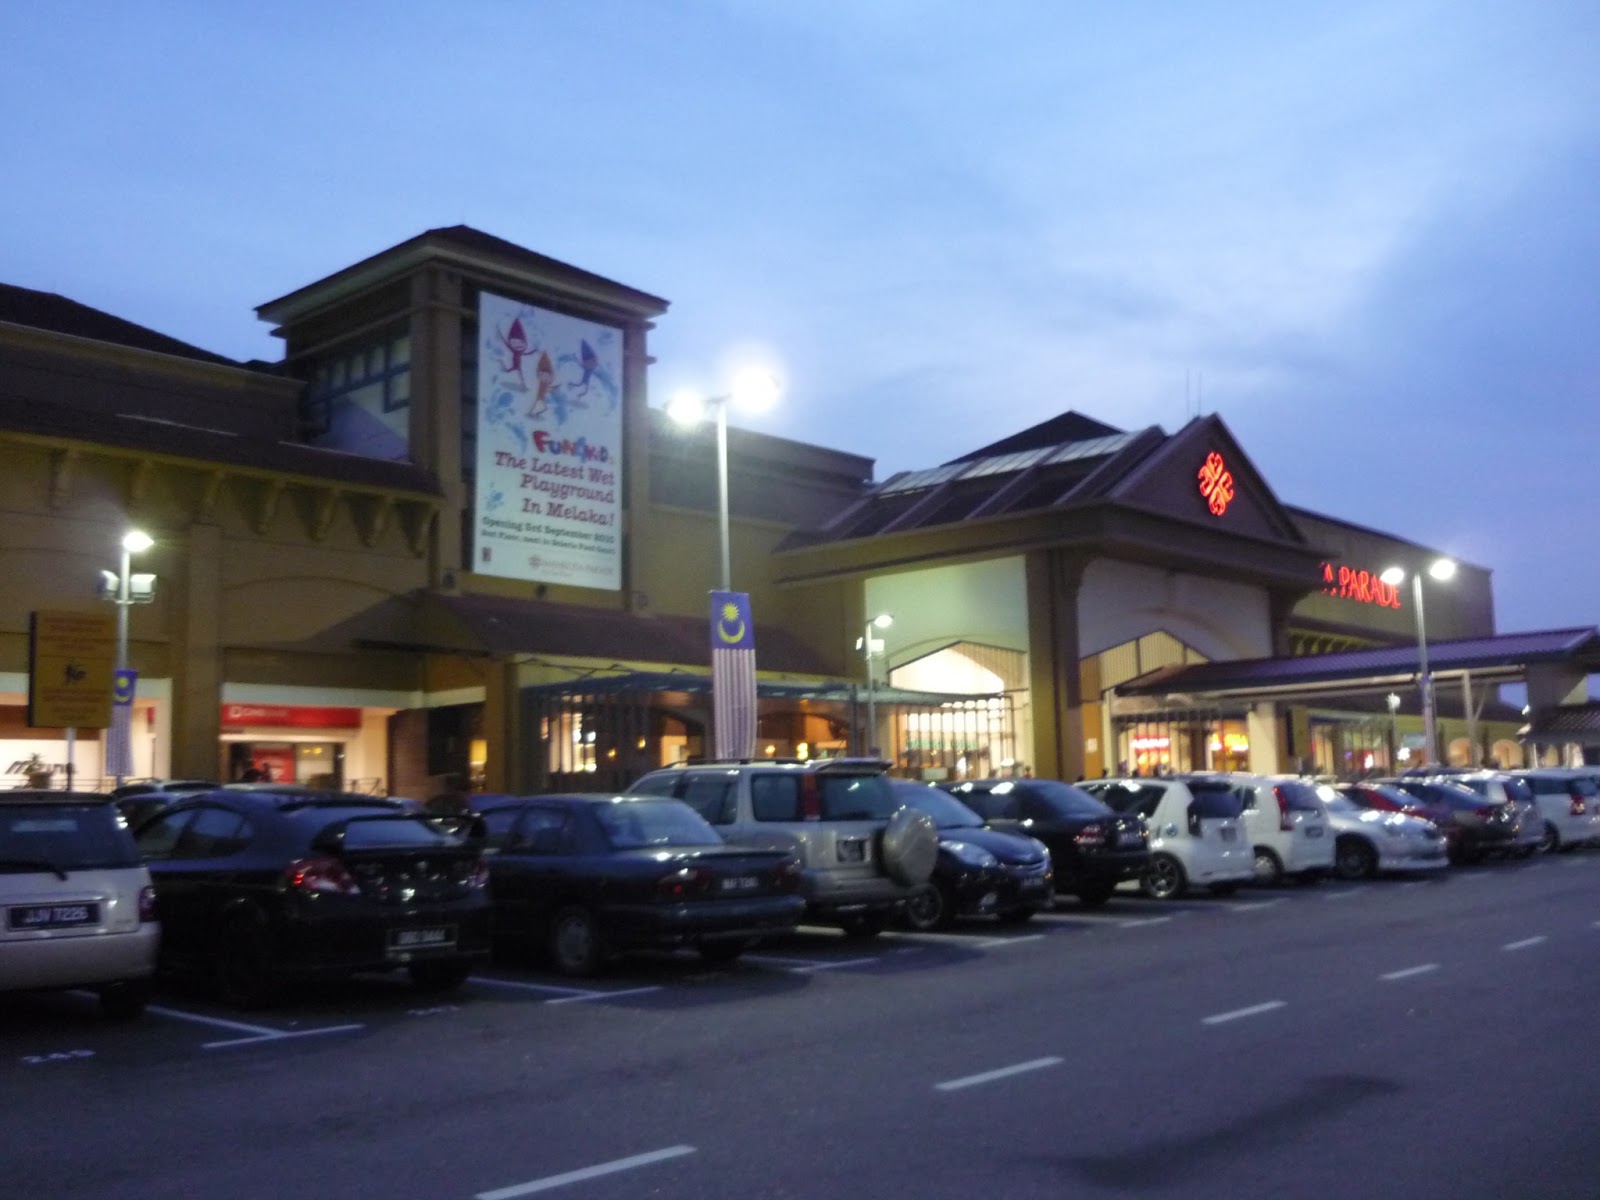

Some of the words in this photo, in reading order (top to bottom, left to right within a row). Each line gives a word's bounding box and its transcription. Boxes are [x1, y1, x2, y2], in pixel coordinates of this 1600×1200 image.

[495, 451, 527, 469] The
[530, 457, 584, 480] Latest
[589, 467, 615, 486] Wet
[520, 473, 615, 503] Playground
[522, 498, 542, 514] In
[546, 502, 615, 527] Melaka!
[482, 516, 522, 531] Opening
[545, 524, 592, 540] September
[1339, 565, 1401, 608] PARADE
